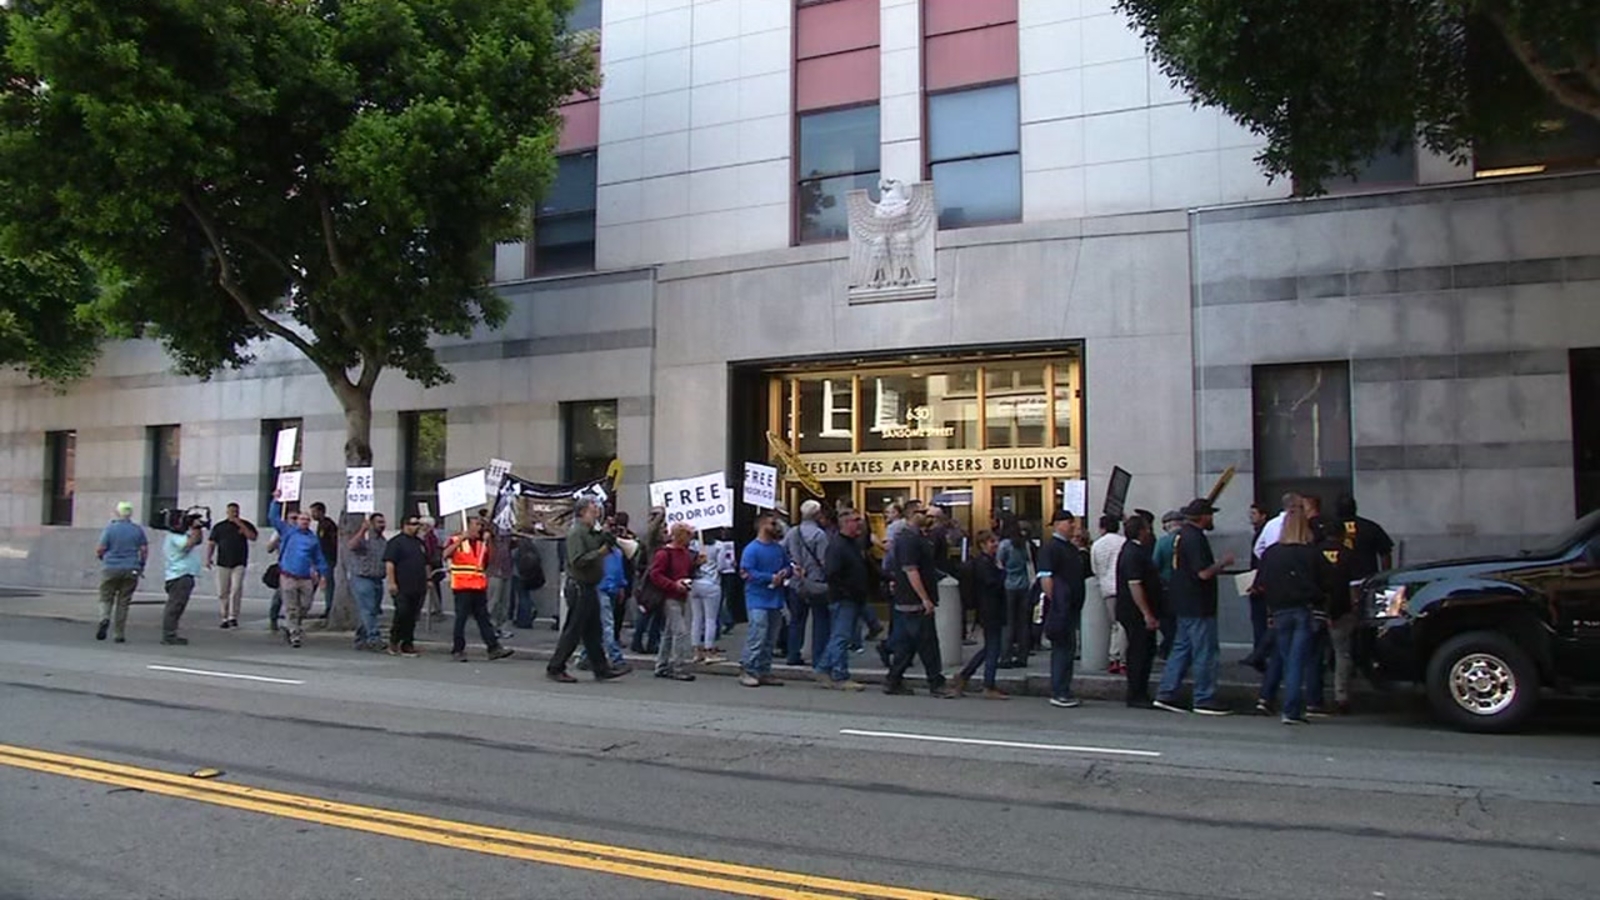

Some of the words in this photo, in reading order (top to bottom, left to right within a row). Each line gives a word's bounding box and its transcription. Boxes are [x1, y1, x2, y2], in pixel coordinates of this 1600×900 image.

[779, 461, 828, 475] UED
[835, 460, 883, 474] STATES
[892, 458, 982, 474] APPRAISERS
[992, 456, 1068, 470] BUILDING
[744, 468, 774, 487] FREE
[663, 483, 721, 507] FREE
[668, 503, 726, 522] RODRIGO
